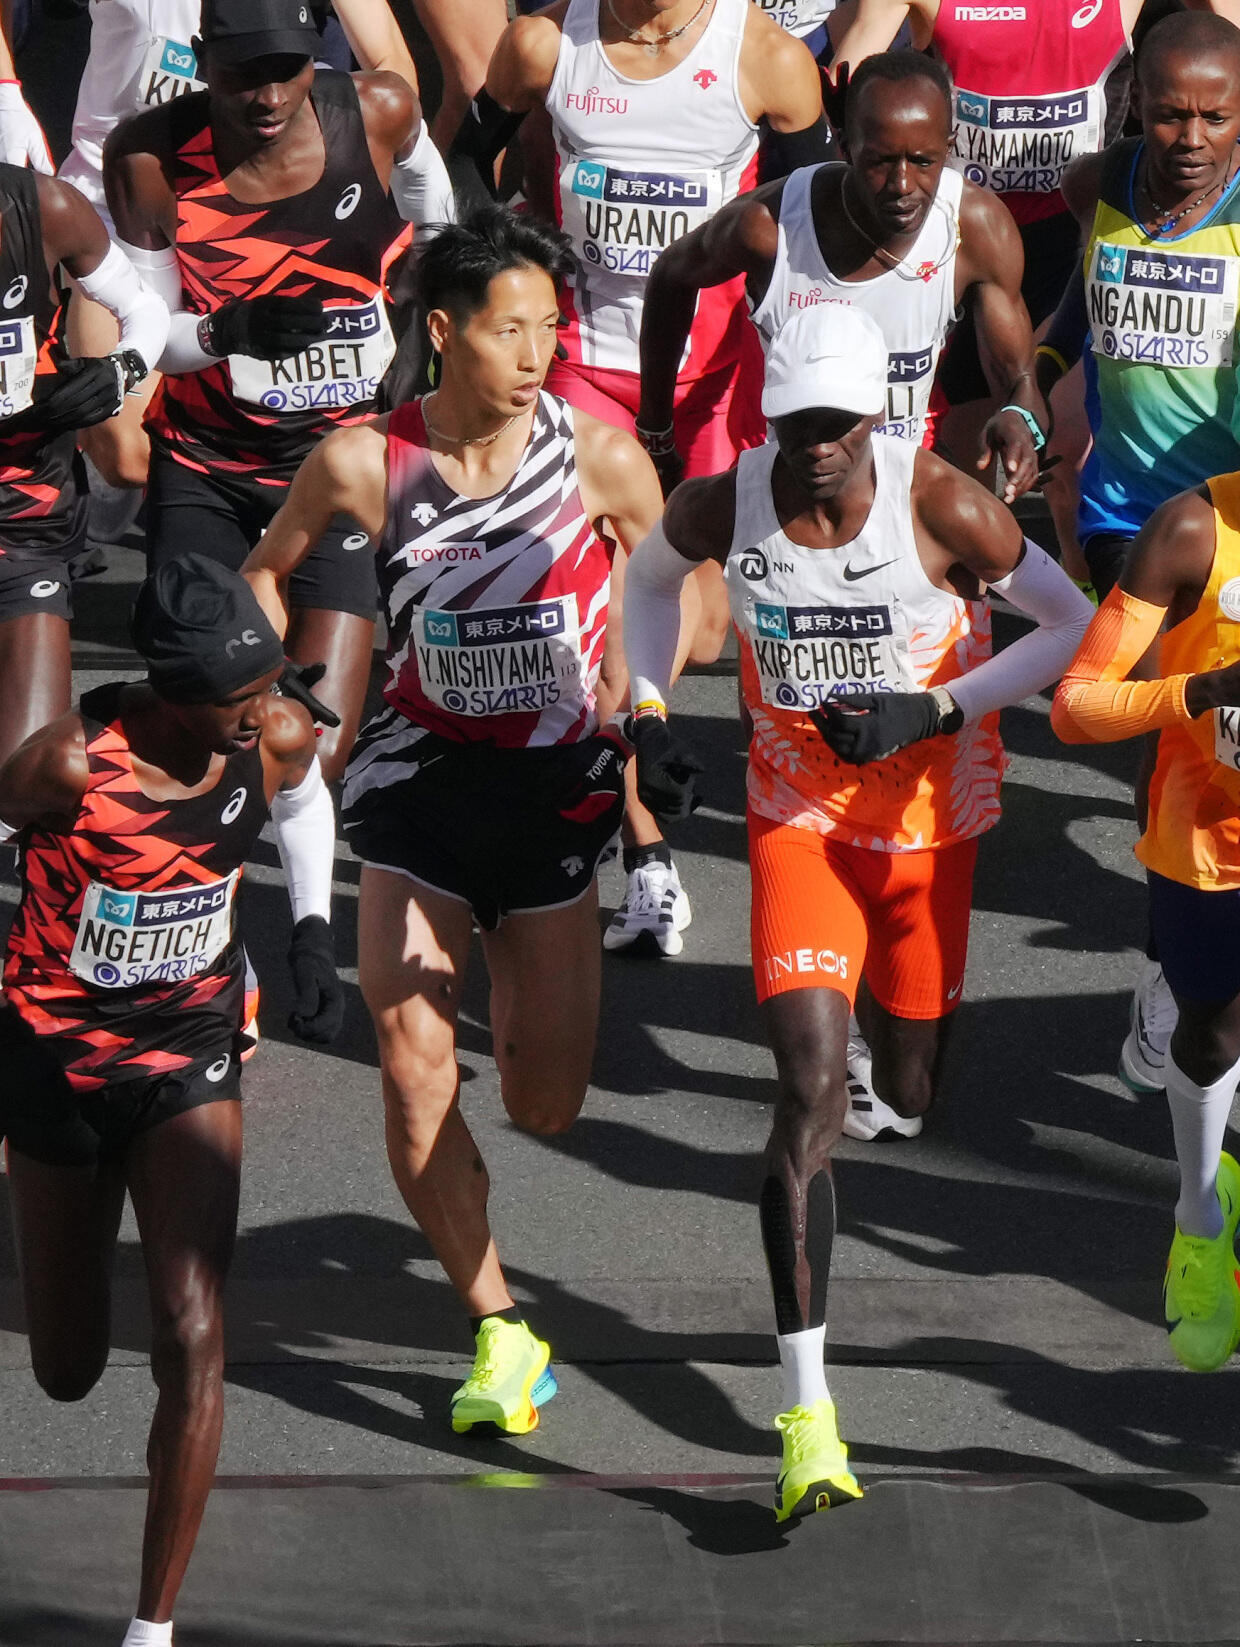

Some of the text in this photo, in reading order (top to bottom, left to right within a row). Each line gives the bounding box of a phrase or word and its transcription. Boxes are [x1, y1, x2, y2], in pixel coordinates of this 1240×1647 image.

[566, 86, 628, 116] FUJITSU
[996, 100, 1083, 124] 東京メトロ
[609, 178, 700, 198] 東京メトロ
[990, 165, 1067, 192] START
[586, 201, 689, 247] URANO
[1129, 259, 1218, 285] 東京メトロ
[1090, 283, 1206, 337] NGANDU
[1120, 332, 1209, 365] STARTS
[1211, 329, 1229, 340] 159
[270, 343, 365, 386] KIBET
[410, 547, 482, 562] TOYOTA
[773, 561, 795, 574] NN
[465, 610, 558, 639] 東京メトロ
[793, 614, 885, 633] 東京メトロ
[419, 642, 556, 689] Y.NISHIYAMA
[560, 663, 577, 677] 113
[754, 639, 885, 682] KIPCHOGE
[470, 681, 561, 715] STARTS
[585, 748, 615, 780] TOYOTA
[141, 891, 225, 920] 東京メトロ
[80, 918, 213, 963] NGETICH
[766, 948, 848, 981] INEOS
